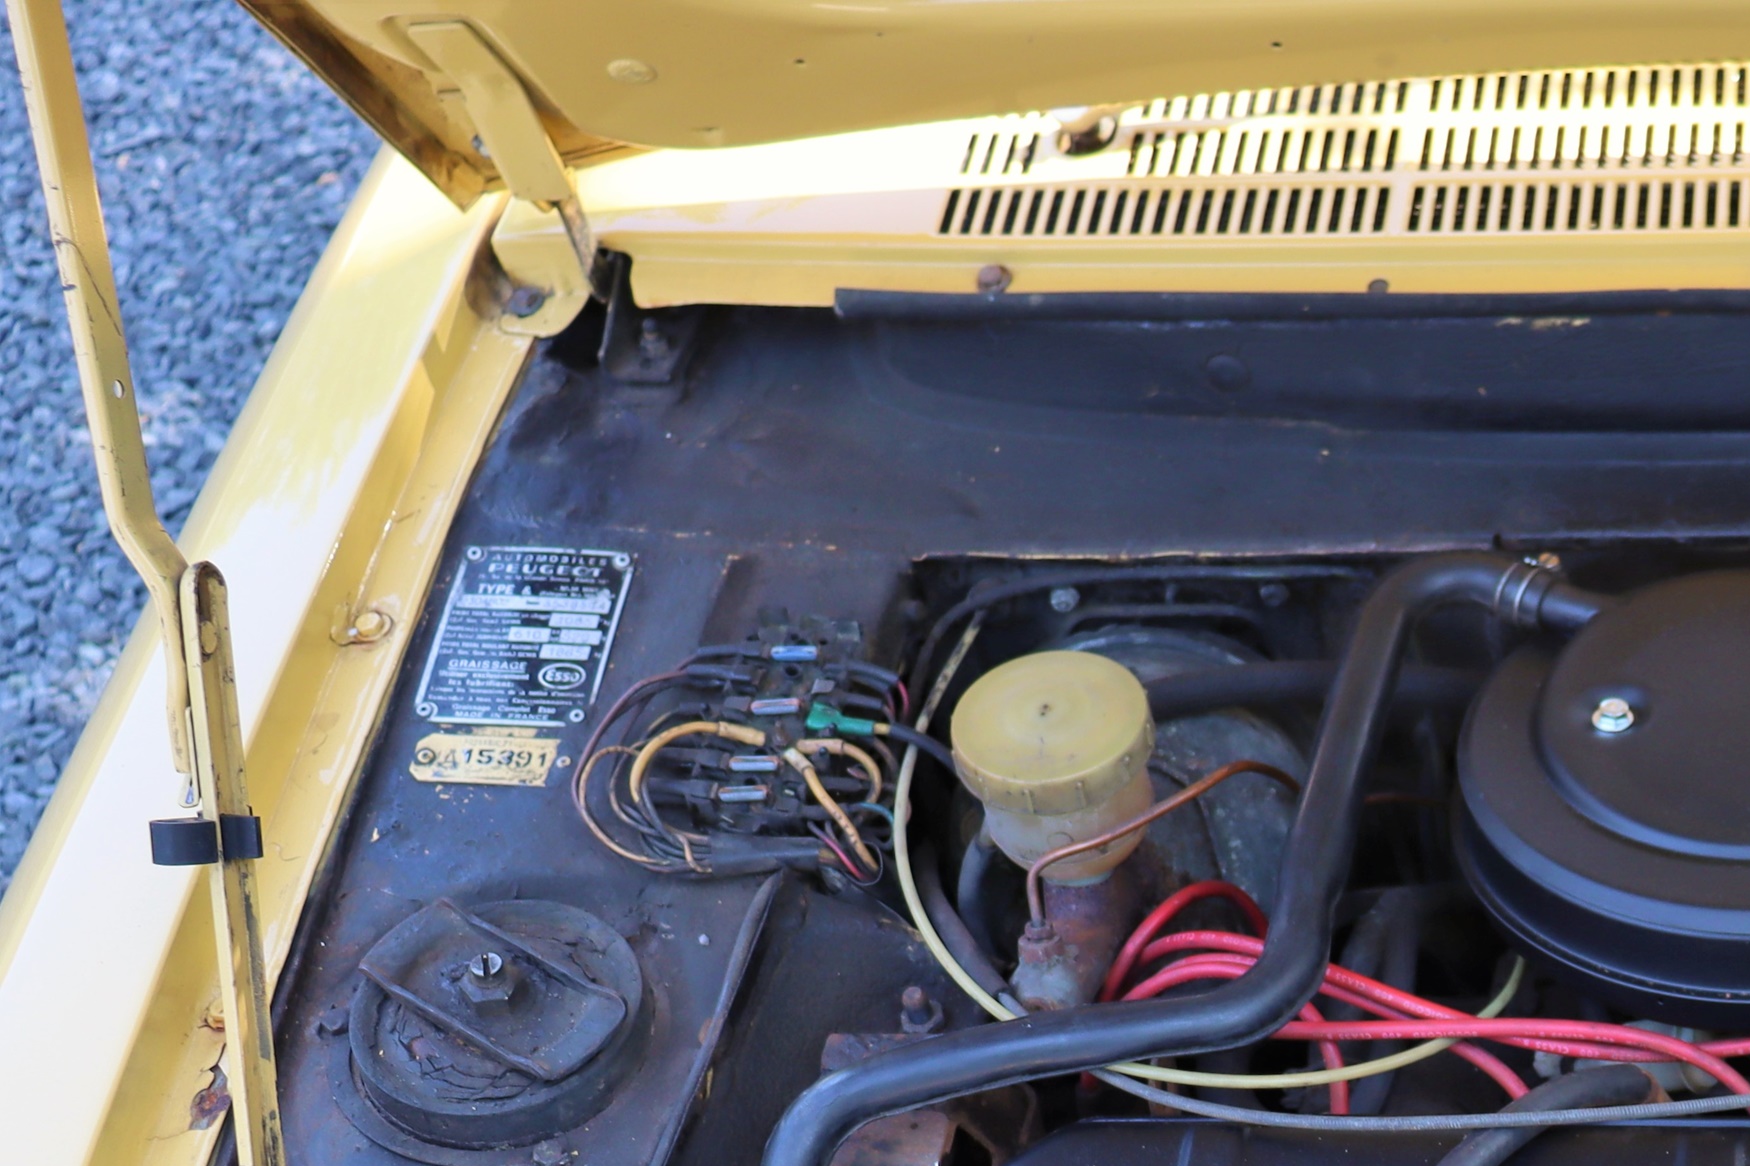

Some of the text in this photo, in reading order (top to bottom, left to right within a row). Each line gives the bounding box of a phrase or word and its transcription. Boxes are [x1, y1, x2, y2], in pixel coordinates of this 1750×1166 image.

[491, 553, 608, 567] AUTOMOBILES
[487, 562, 604, 578] PEUGEOT
[478, 583, 515, 595] TYPE
[449, 659, 528, 671] GRAISSAGE
[454, 711, 486, 719] MADE
[507, 713, 550, 721] FRANCE
